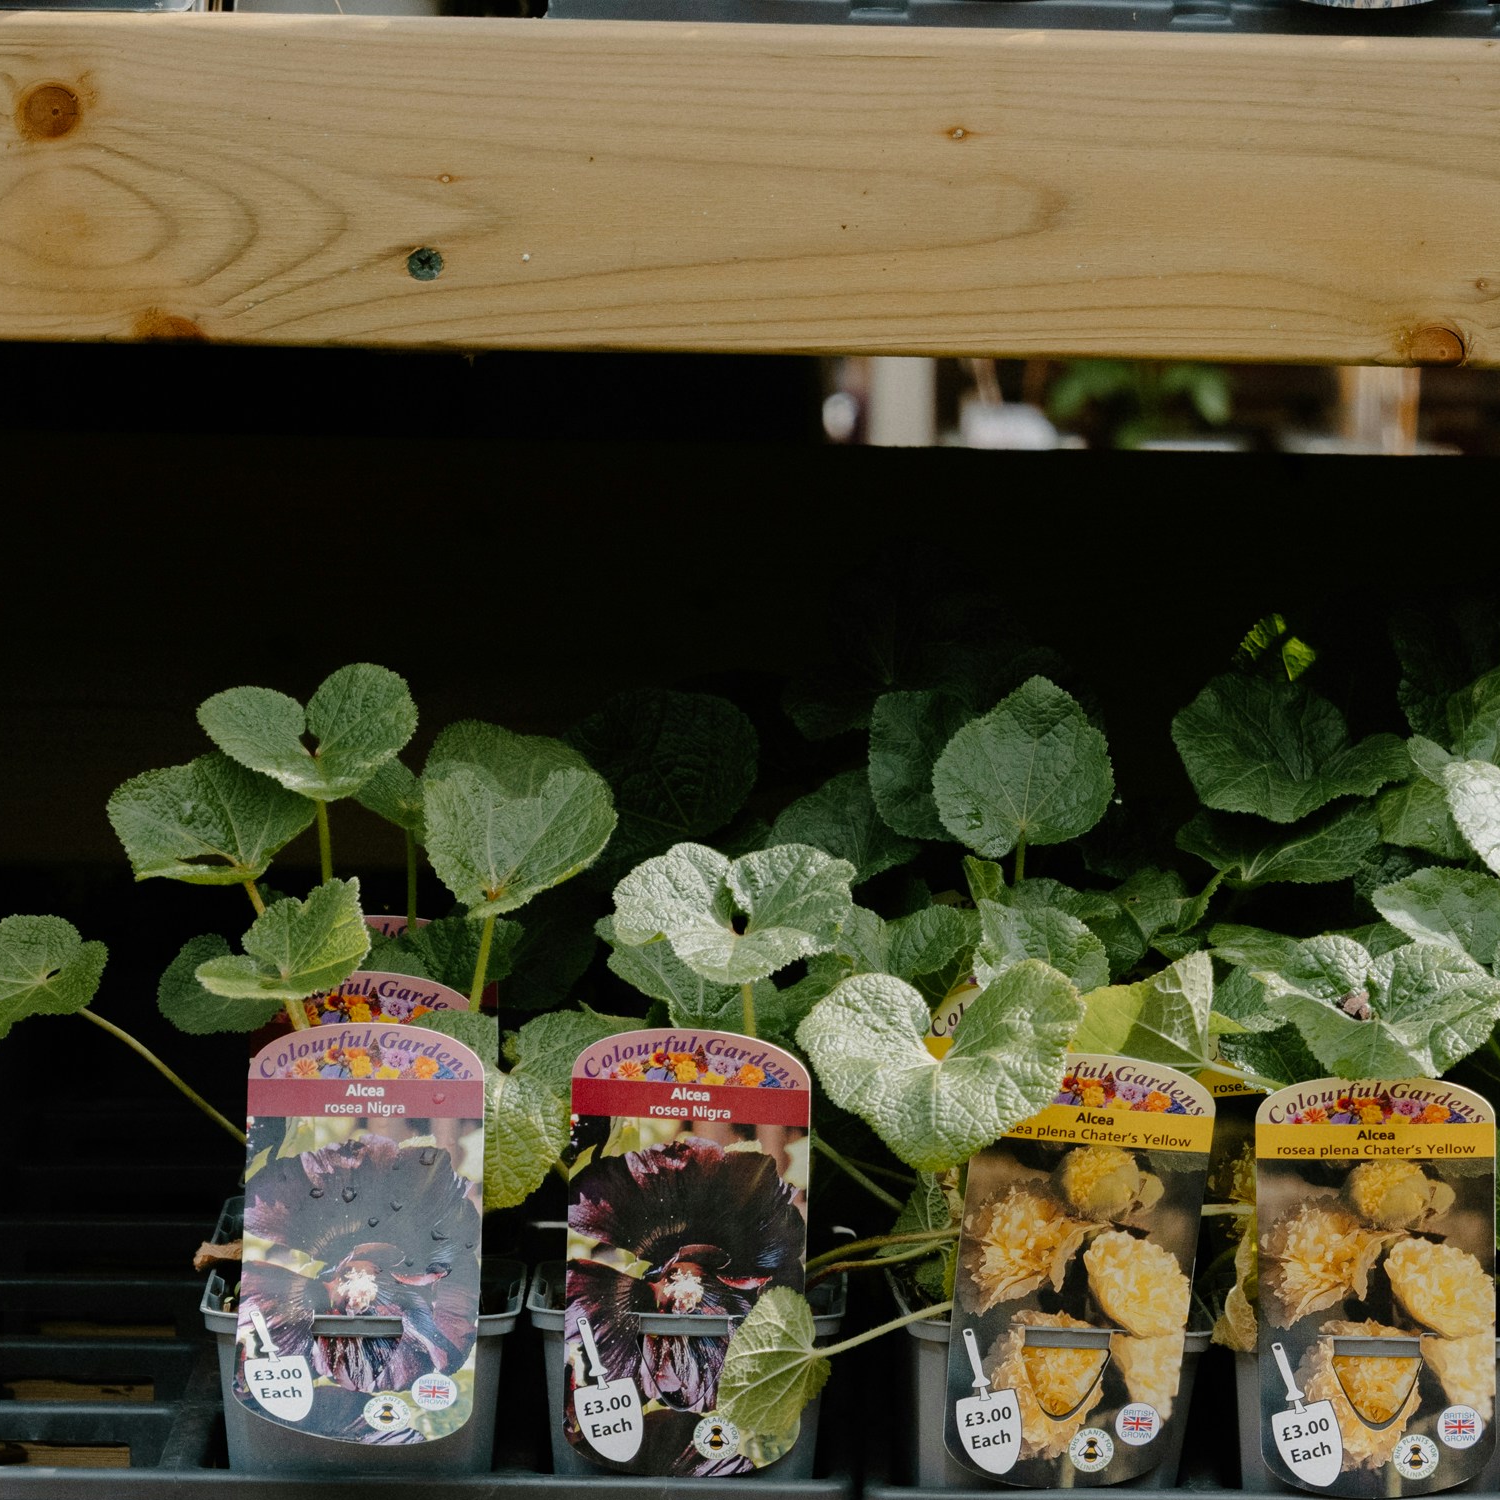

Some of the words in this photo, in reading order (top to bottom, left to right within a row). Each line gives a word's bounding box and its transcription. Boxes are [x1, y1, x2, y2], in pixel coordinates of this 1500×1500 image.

[1268, 1082, 1382, 1124] Colourful
[1389, 1083, 1486, 1124] Gardens
[1356, 1130, 1396, 1141] Alcea
[1276, 1145, 1315, 1156] rosea
[1320, 1144, 1360, 1158] plena
[1363, 1144, 1422, 1156] Chater's
[1426, 1143, 1476, 1155] Yellow
[1282, 1417, 1330, 1442] £3.00
[1290, 1442, 1333, 1464] Each
